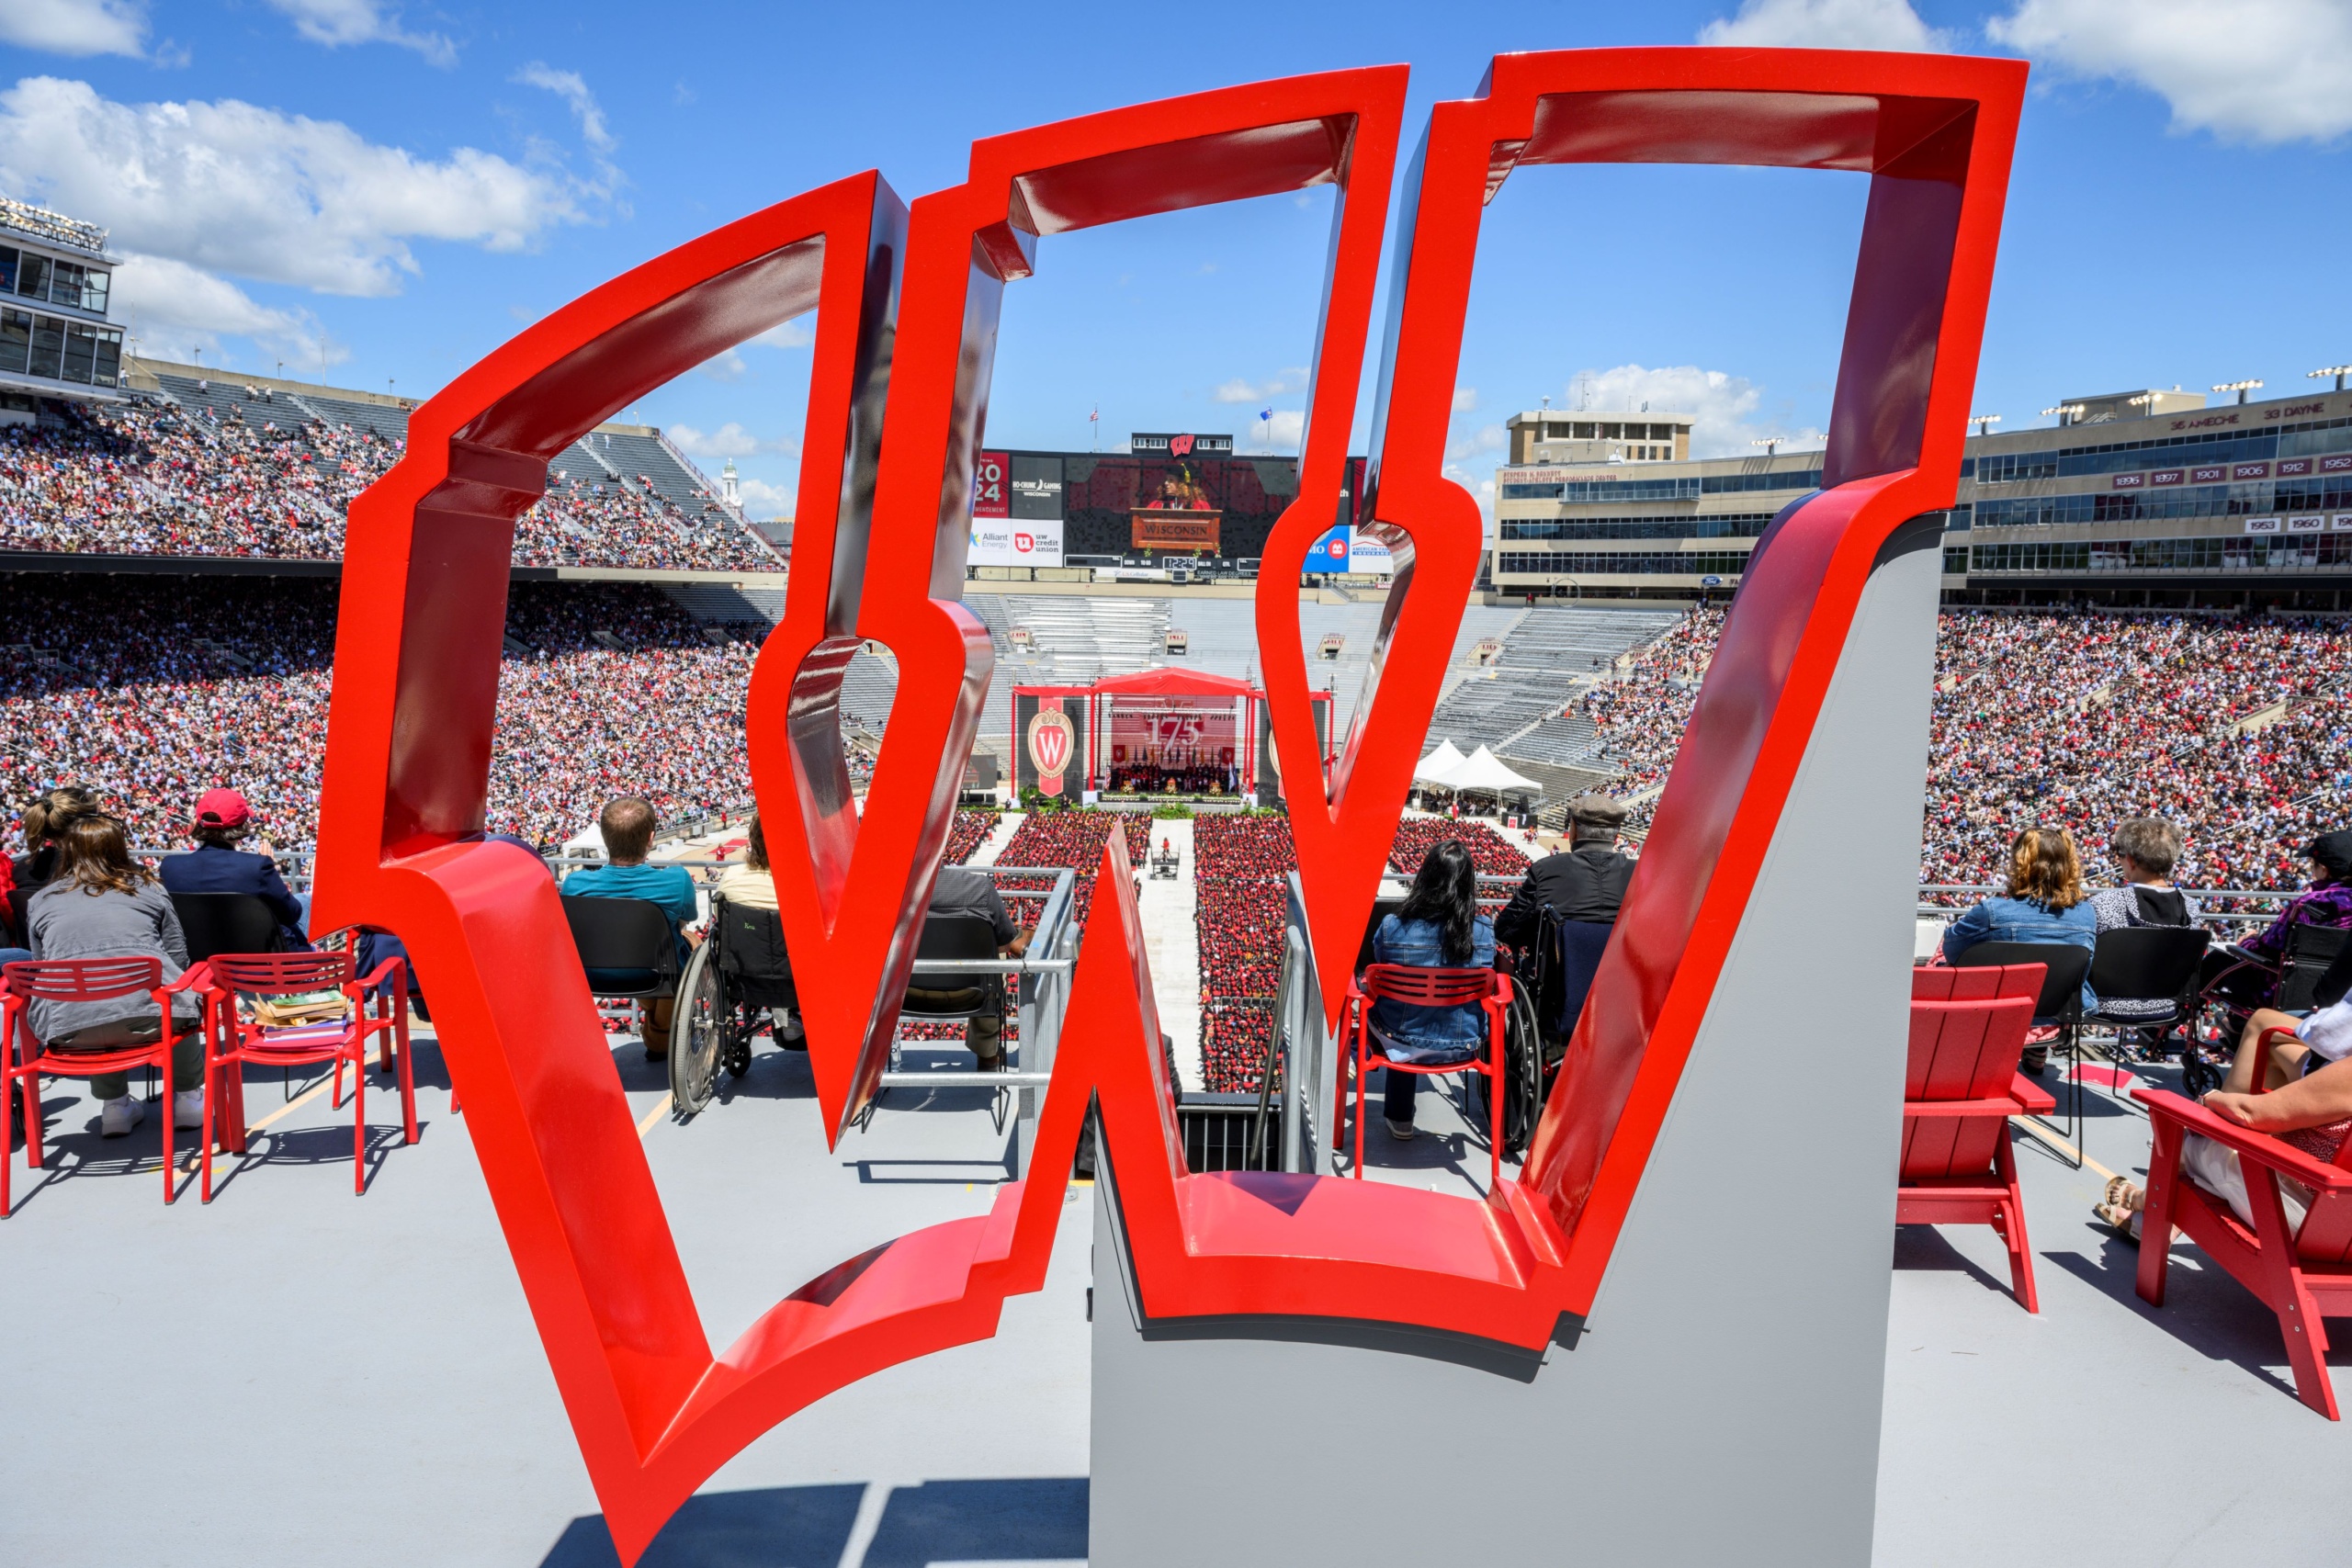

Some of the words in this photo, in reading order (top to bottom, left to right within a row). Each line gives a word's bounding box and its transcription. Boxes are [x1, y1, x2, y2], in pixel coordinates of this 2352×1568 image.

[2264, 410, 2280, 420] 33
[2284, 402, 2324, 418] DAYNE
[2170, 422, 2186, 431] 35
[2188, 414, 2239, 428] AMECHE
[1170, 434, 1194, 457] W
[2283, 463, 2304, 472] 1912
[2324, 458, 2351, 468] 1952
[2197, 470, 2219, 479] 1901
[2236, 467, 2263, 477] 1906
[2116, 476, 2140, 486] 1896
[2154, 473, 2178, 482] 1897
[1012, 480, 1036, 489] HO-CHUNK
[2251, 521, 2276, 530] 1953
[2293, 518, 2320, 528] 1960
[2337, 517, 2352, 527] 19
[1145, 525, 1208, 536] WISCONSIN
[982, 533, 1008, 541] Alliant
[1308, 546, 1325, 554] MO
[1148, 716, 1199, 754] 175
[1039, 731, 1063, 764] W
